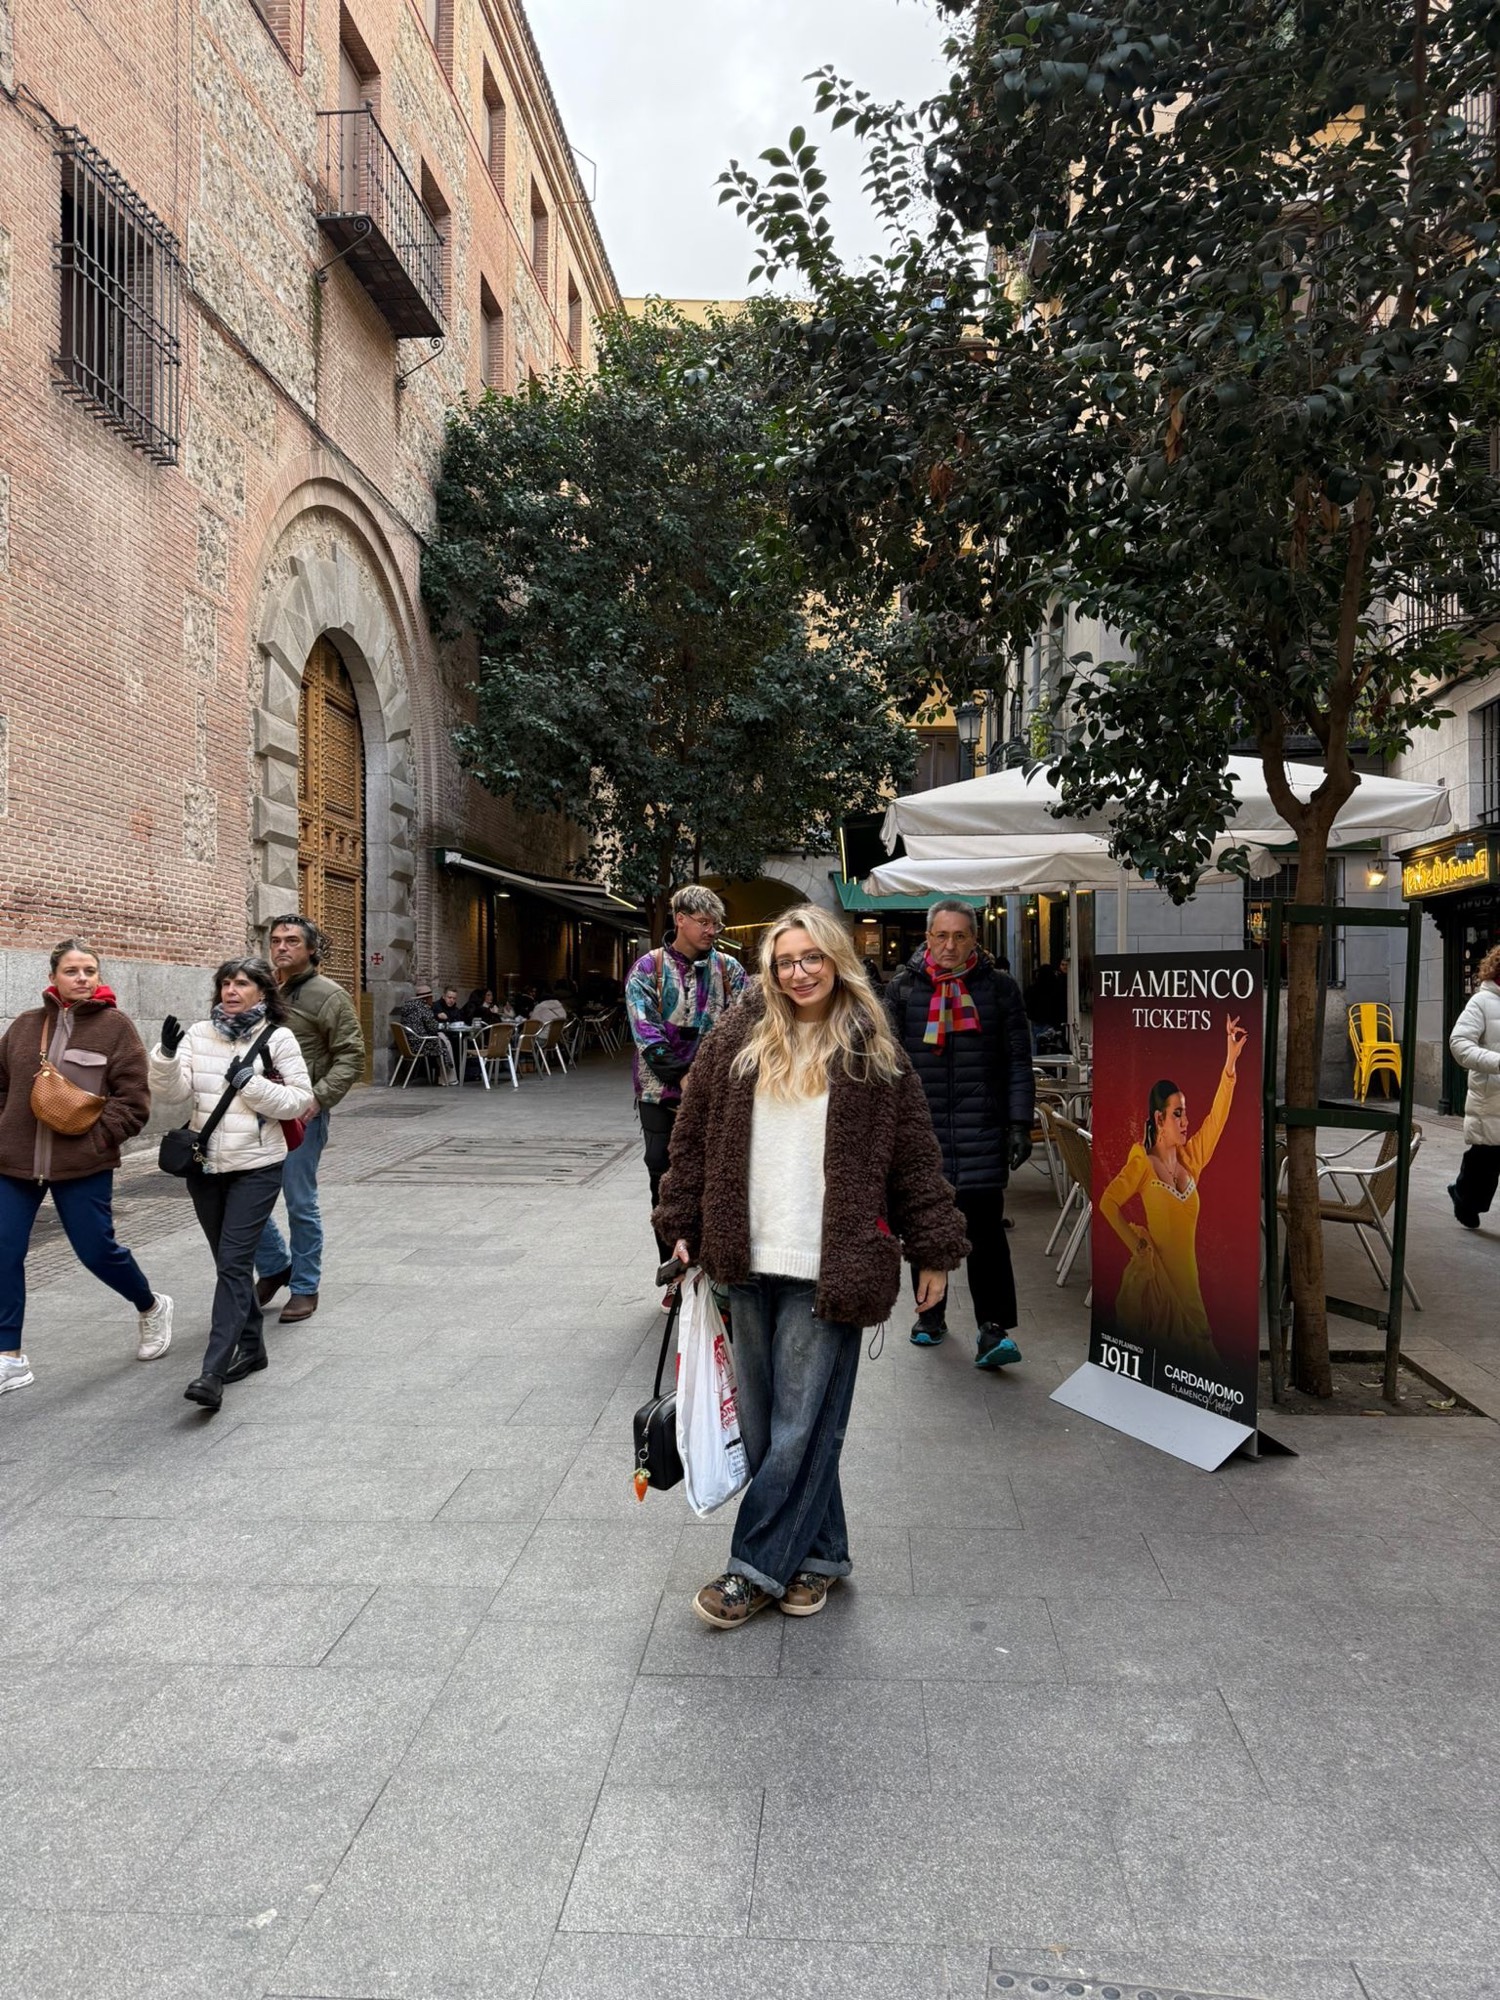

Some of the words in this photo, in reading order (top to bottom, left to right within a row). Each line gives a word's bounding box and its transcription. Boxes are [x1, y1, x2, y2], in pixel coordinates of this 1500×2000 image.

[1099, 968, 1254, 999] FLAMENCO
[1132, 1008, 1211, 1031] TICKETS
[1118, 1339, 1144, 1354] FLAMENCO
[1099, 1344, 1142, 1381] 1911
[1164, 1365, 1244, 1405] CARDAMOMO
[1171, 1383, 1208, 1404] FLAMENCO
